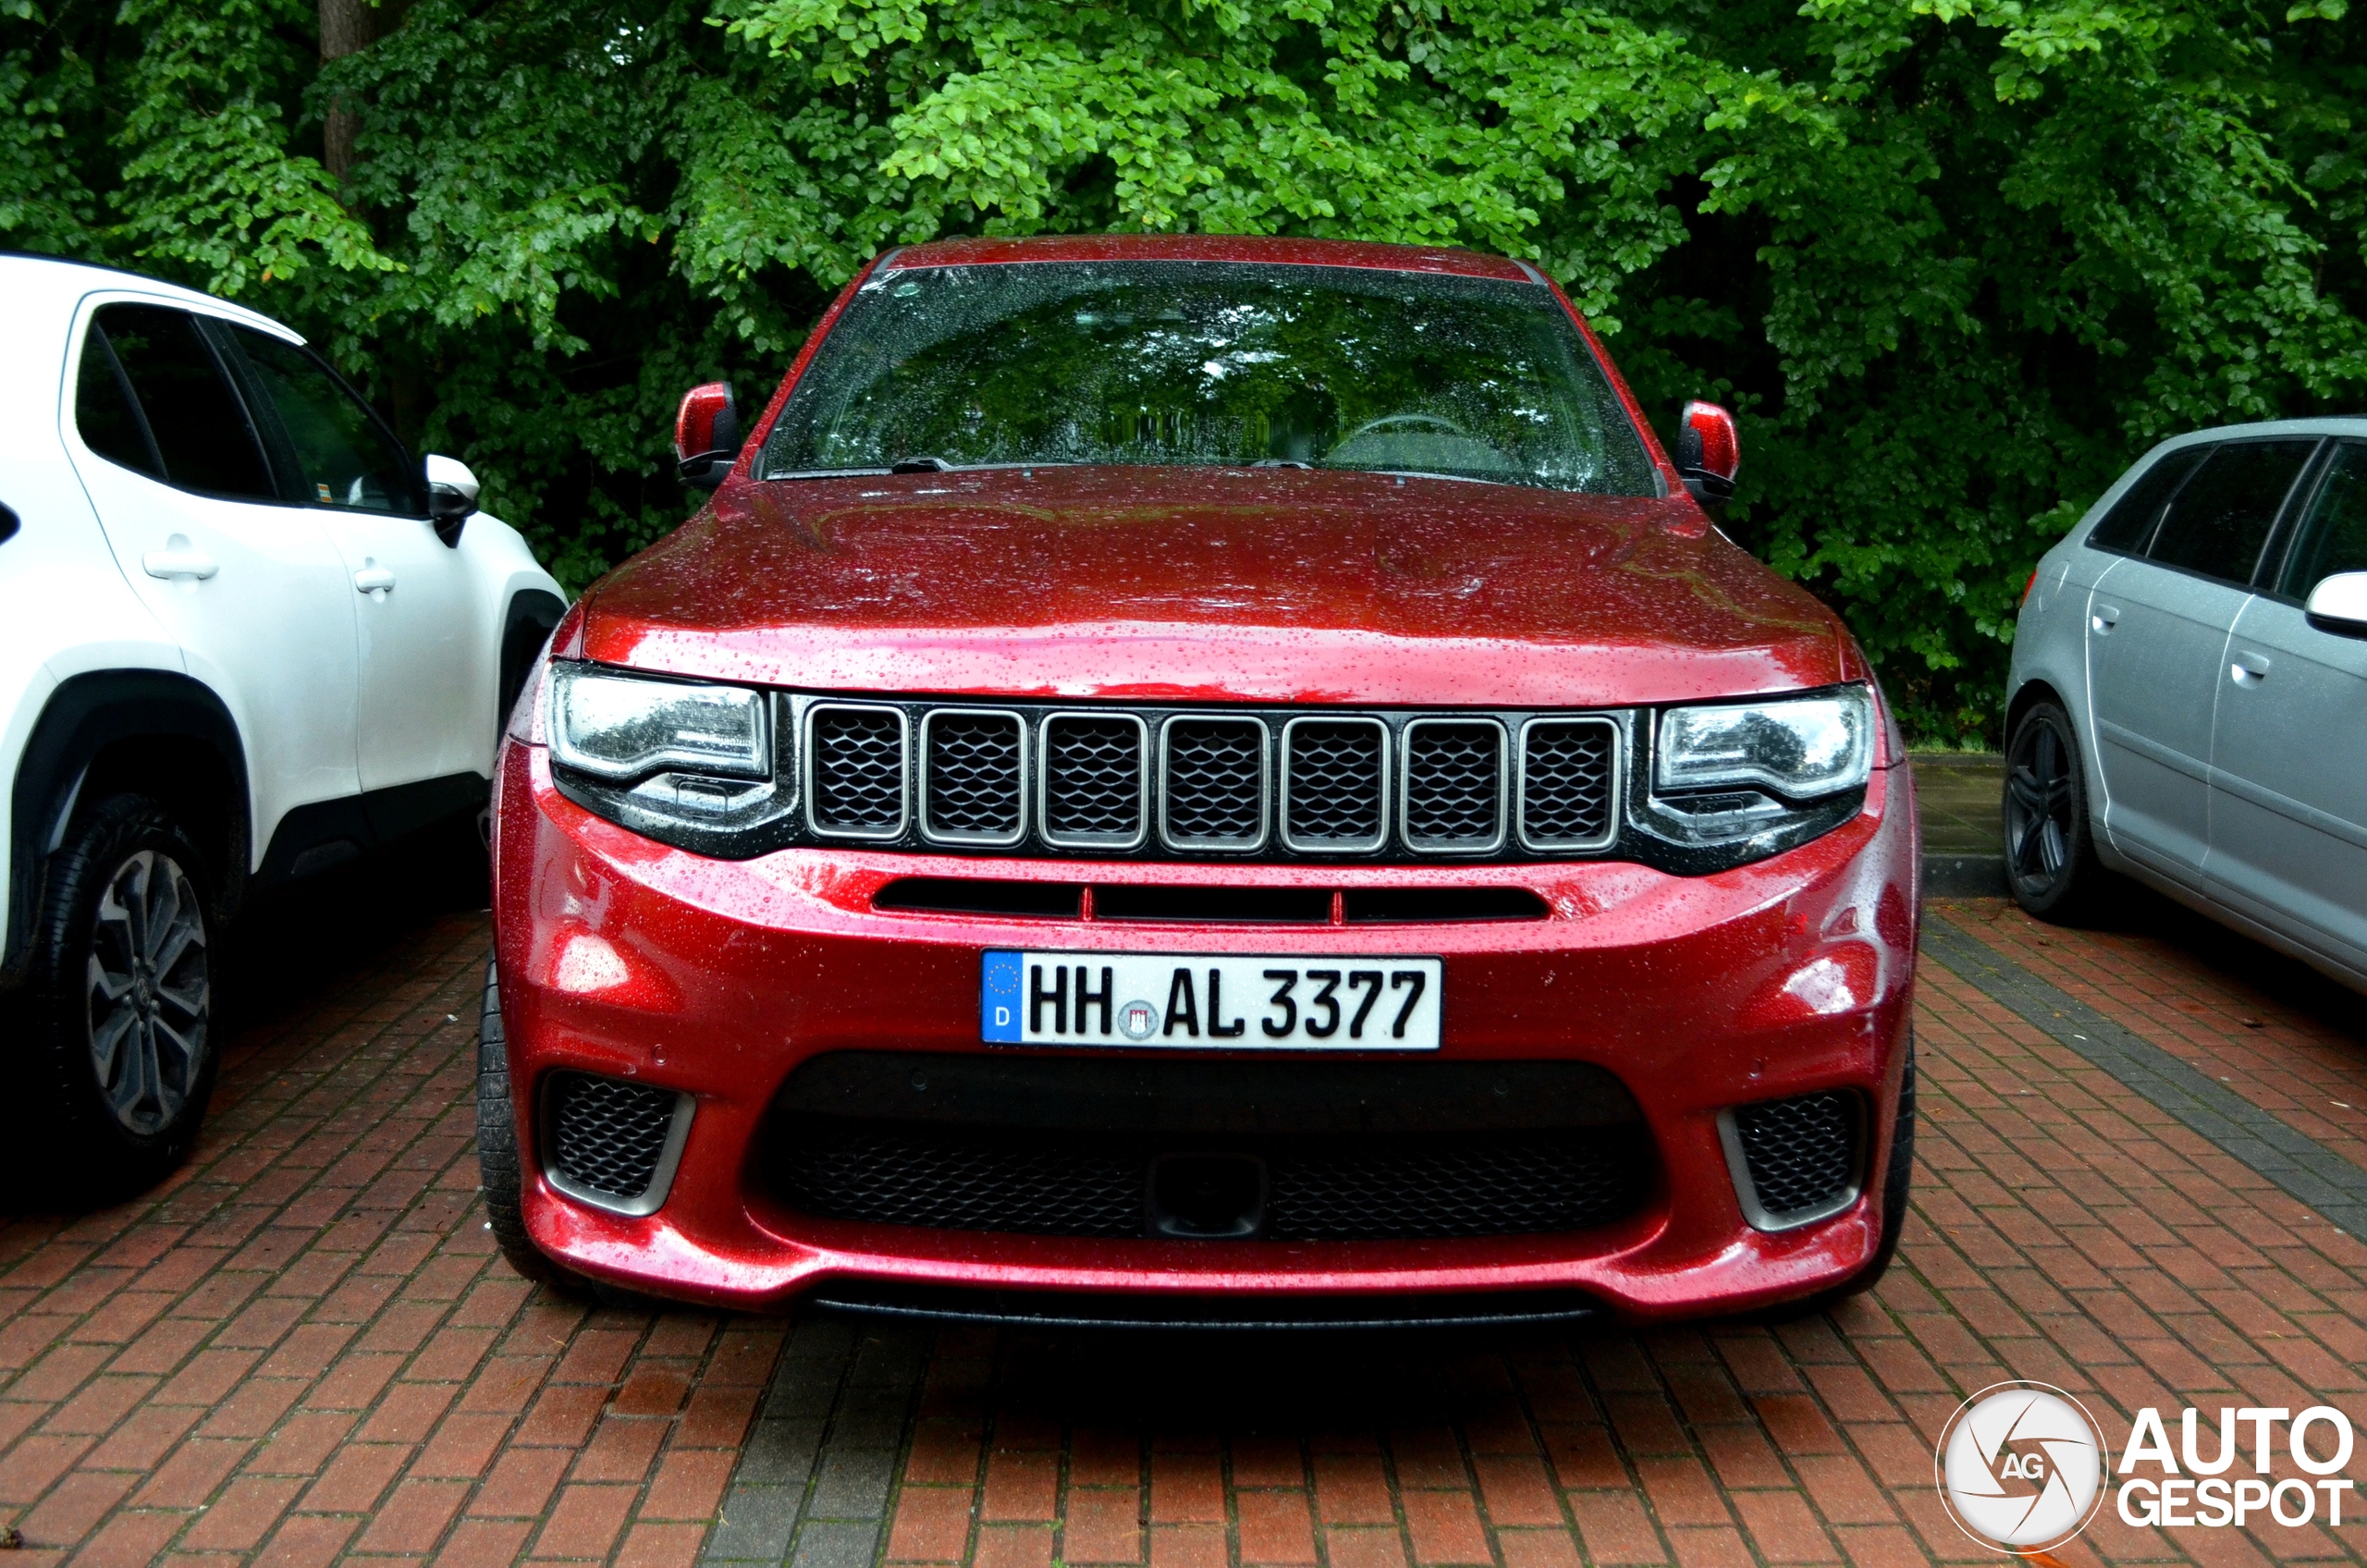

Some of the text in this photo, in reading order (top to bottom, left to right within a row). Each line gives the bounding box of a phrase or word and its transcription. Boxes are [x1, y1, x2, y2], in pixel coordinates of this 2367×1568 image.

[995, 1006, 1011, 1026] D
[1029, 964, 1113, 1035] HH
[1162, 967, 1245, 1037] AL
[1261, 969, 1427, 1038] 3377
